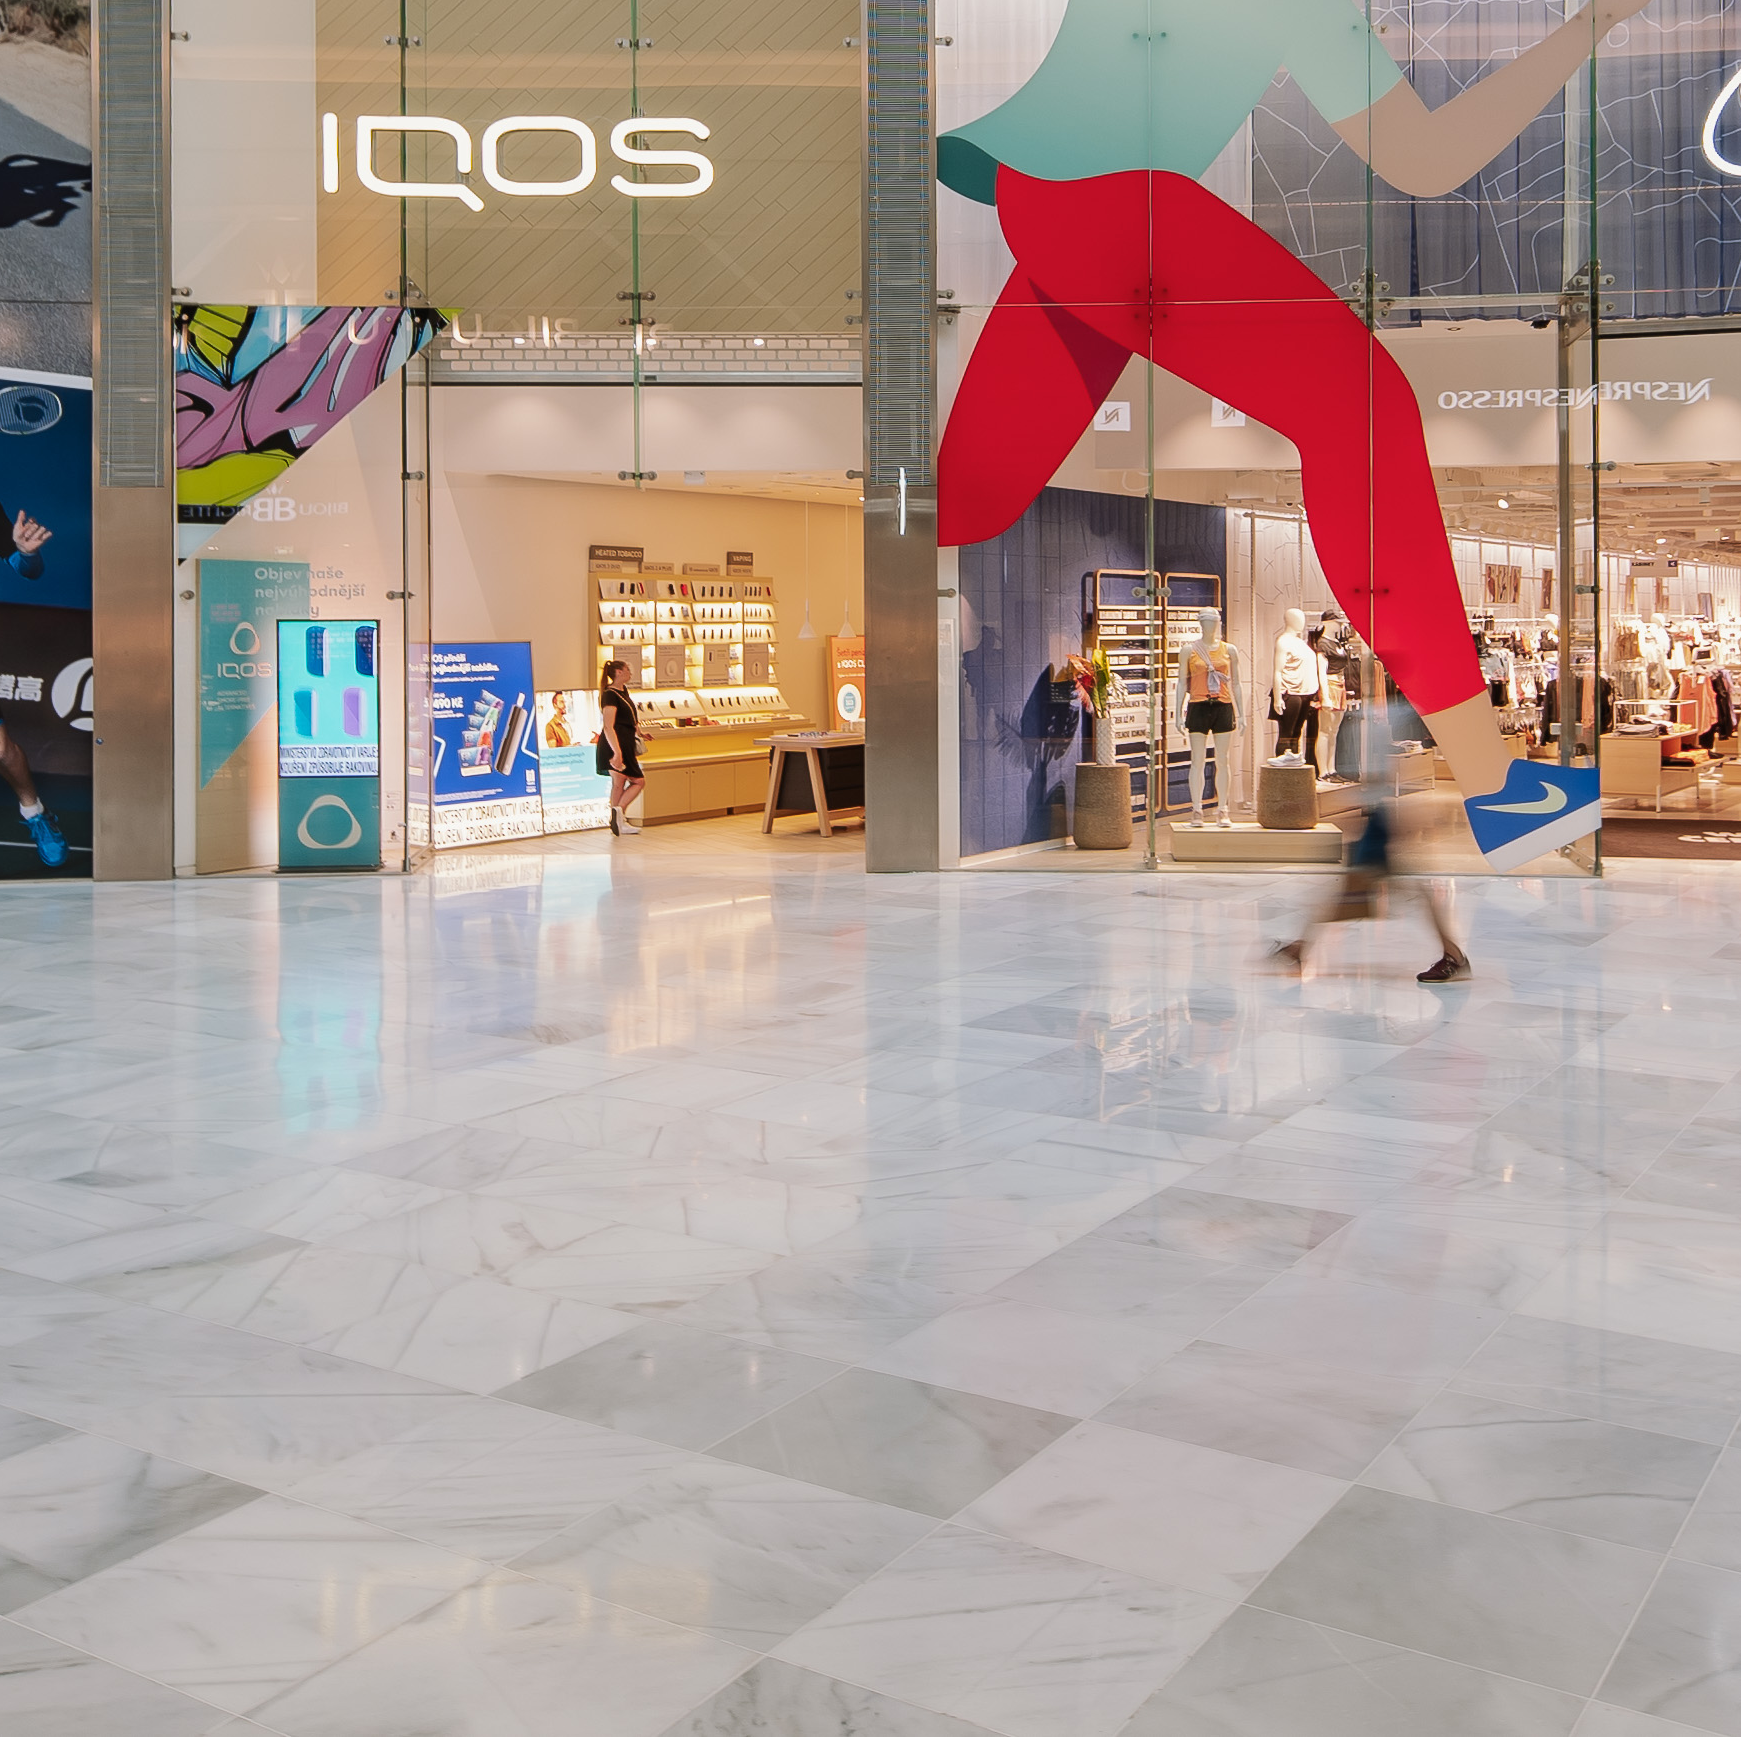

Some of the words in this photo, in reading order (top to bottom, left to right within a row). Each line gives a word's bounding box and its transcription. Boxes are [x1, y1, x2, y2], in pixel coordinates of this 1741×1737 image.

[322, 111, 715, 213] IQOS
[254, 566, 302, 583] Objev
[307, 565, 345, 580] naše
[217, 662, 274, 680] IQOS
